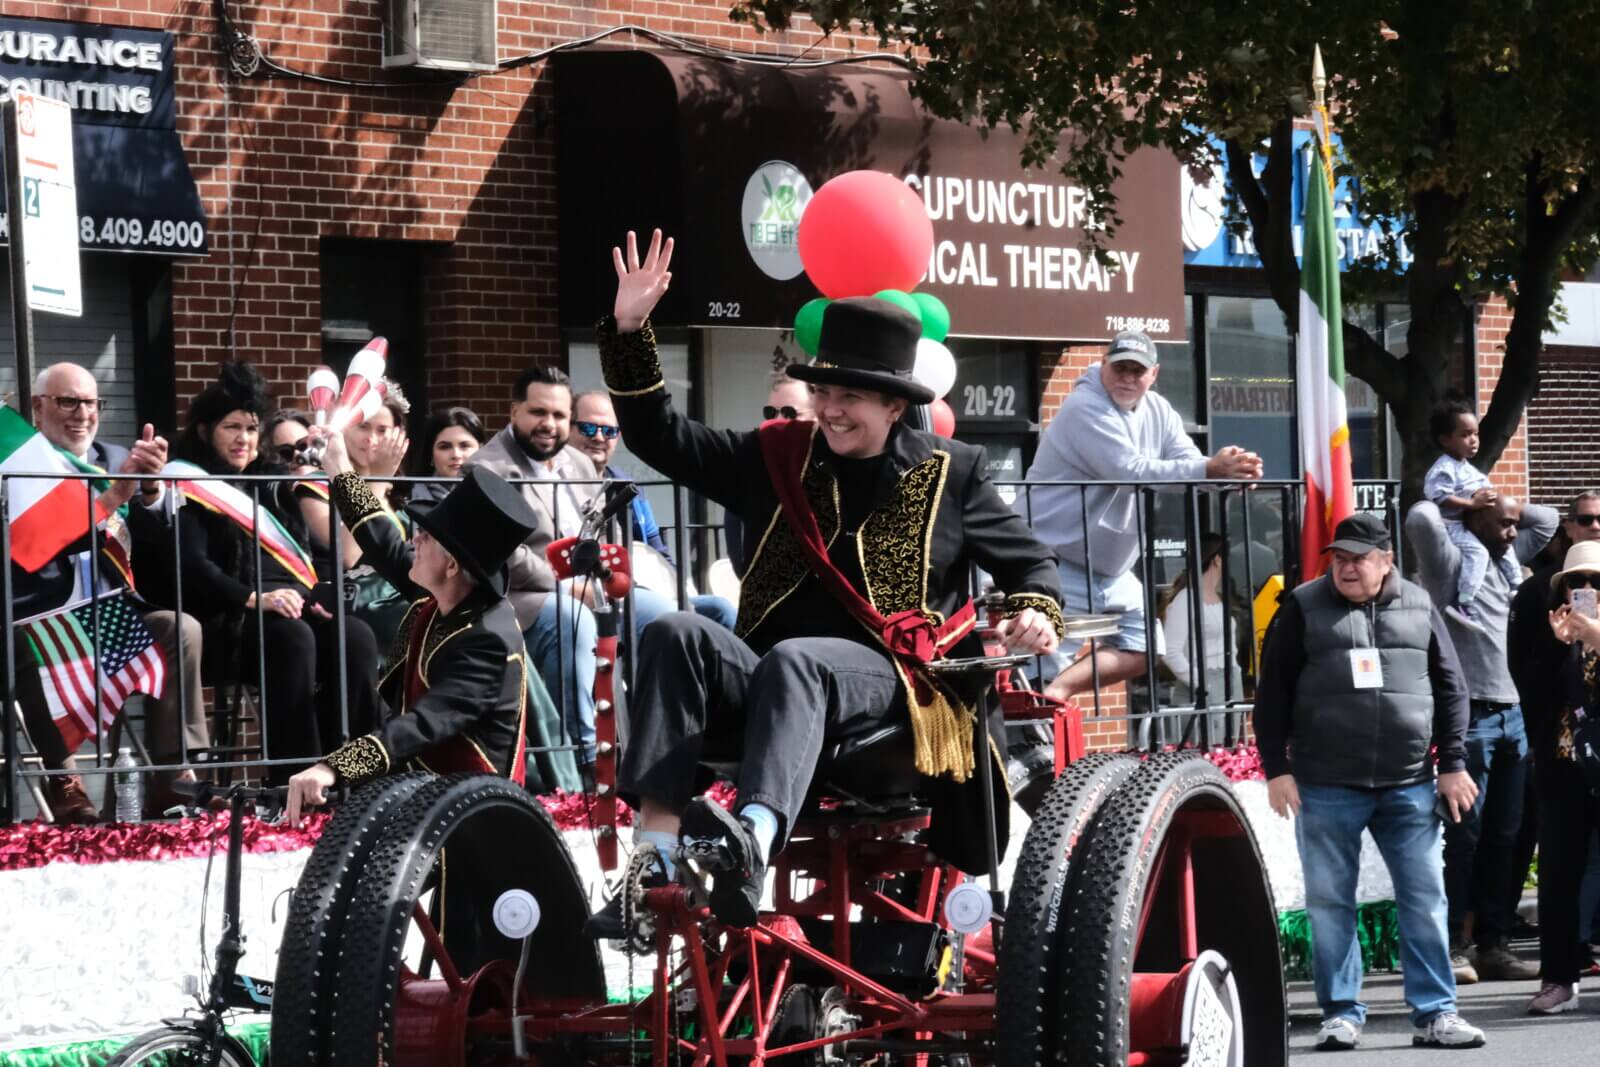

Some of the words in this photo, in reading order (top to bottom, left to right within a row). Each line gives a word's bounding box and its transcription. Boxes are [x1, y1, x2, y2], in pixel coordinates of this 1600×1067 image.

[0, 30, 162, 71] URANCE
[919, 240, 998, 287] ICAL
[1003, 244, 1140, 293] THERAPY
[708, 302, 741, 318] 20-22
[963, 385, 1016, 416] 20-22
